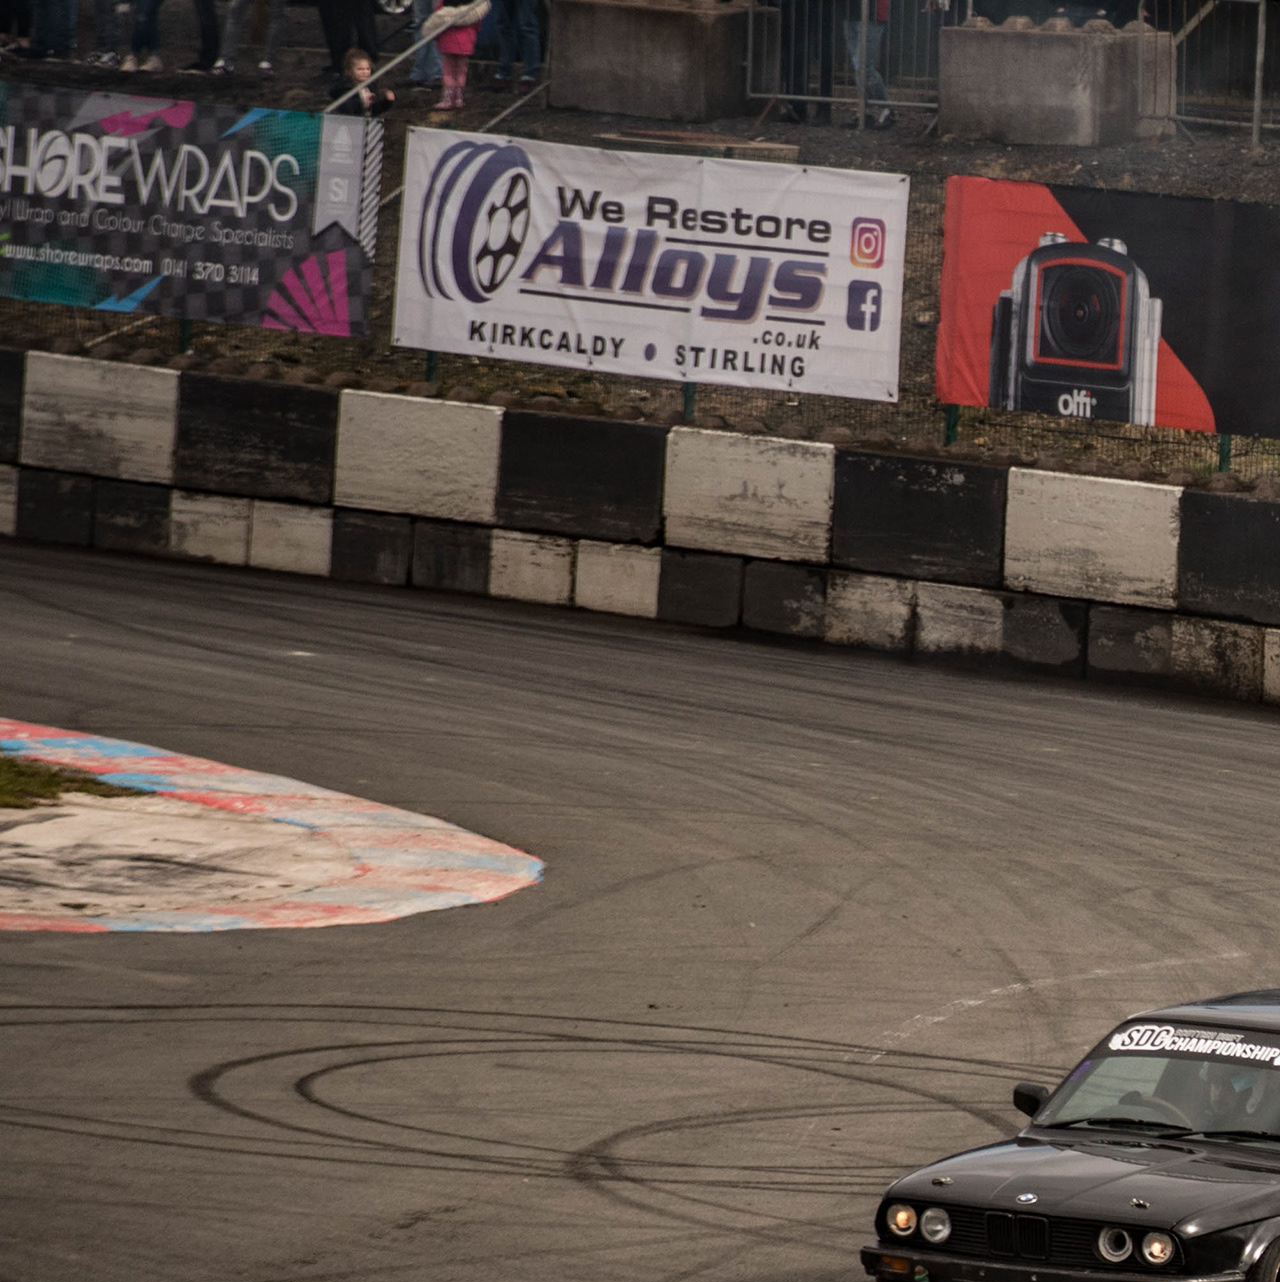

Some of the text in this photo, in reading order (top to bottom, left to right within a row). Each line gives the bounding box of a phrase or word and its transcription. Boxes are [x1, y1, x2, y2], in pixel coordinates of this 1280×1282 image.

[0, 125, 300, 222] HOREWRAPS
[14, 199, 55, 226] Wrap
[57, 203, 89, 228] and
[93, 207, 144, 232] Colour
[150, 214, 205, 244] Change
[210, 221, 295, 249] Specialists
[557, 186, 832, 243] We Restore
[5, 242, 153, 274] www.shorewraps.com
[193, 261, 225, 282] 370
[519, 220, 828, 325] Alloys
[469, 321, 806, 378] KIRKCALDY STIRLING
[752, 329, 821, 351] .co.uk
[1120, 1025, 1174, 1050] SDC
[1166, 1036, 1280, 1062] CHAMPIONSHIP
